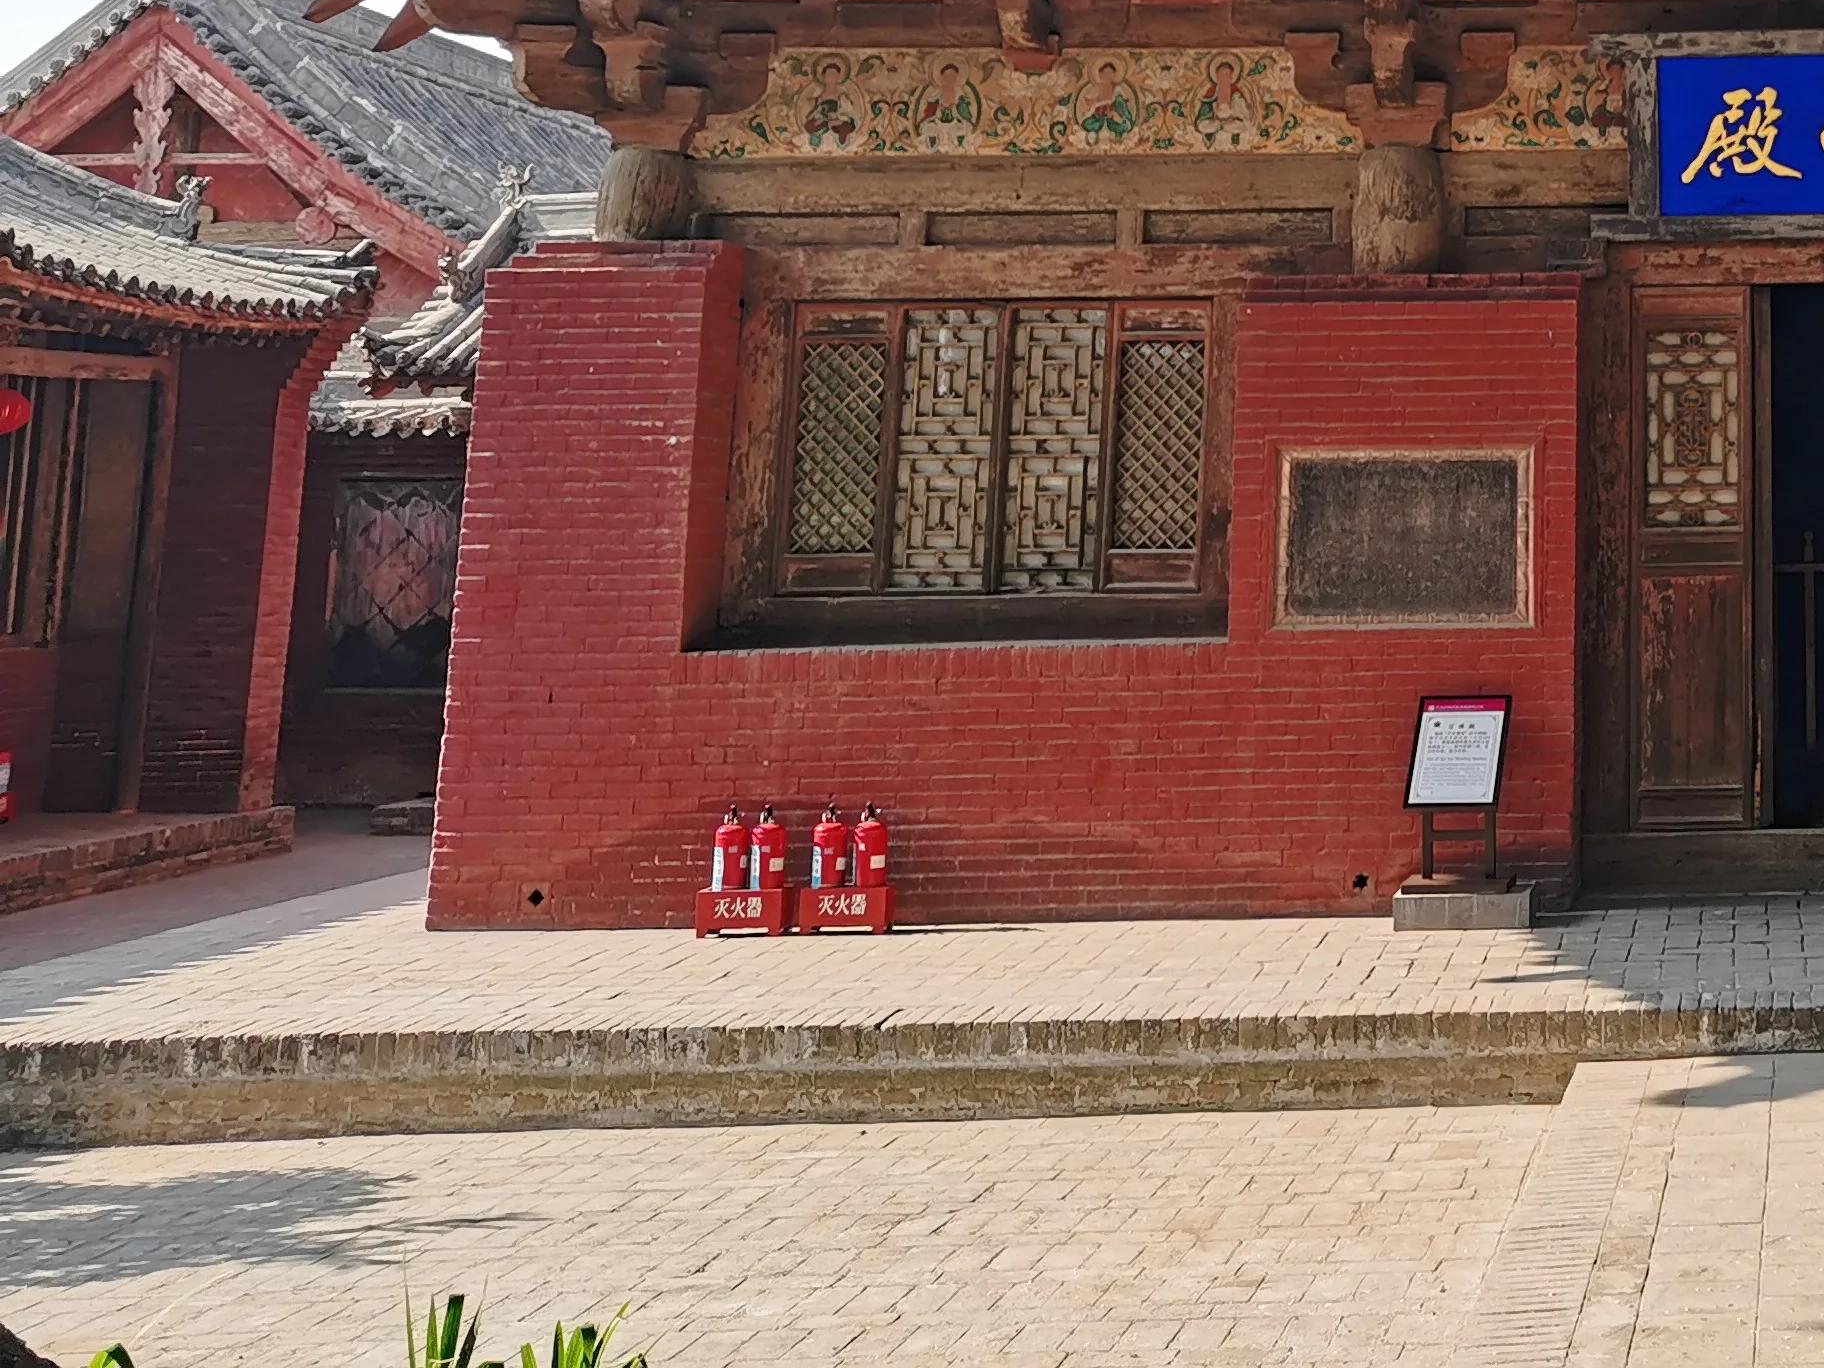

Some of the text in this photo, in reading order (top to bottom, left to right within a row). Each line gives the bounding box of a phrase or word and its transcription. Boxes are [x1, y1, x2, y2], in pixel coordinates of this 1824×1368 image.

[713, 896, 763, 919] 灭火器
[817, 893, 867, 916] 灭火器
